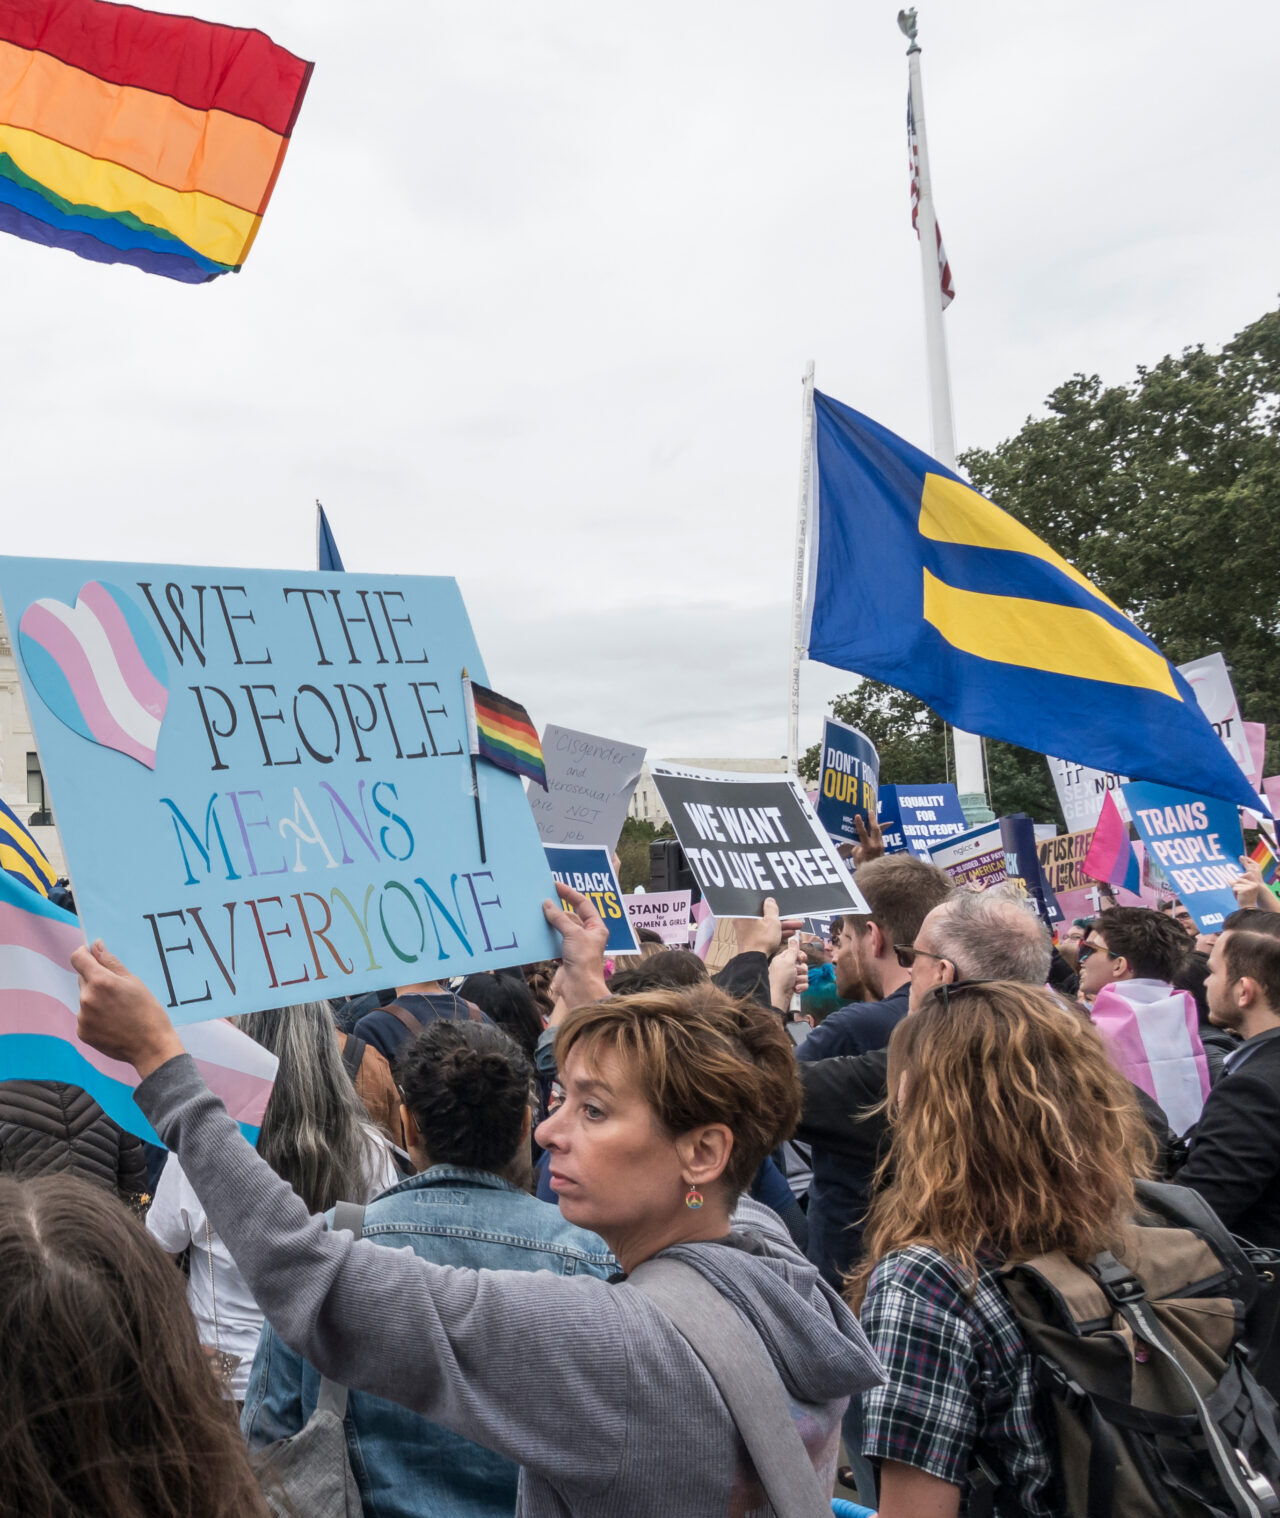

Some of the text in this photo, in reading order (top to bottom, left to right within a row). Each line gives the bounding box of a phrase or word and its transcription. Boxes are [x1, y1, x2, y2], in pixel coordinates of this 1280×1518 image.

[136, 582, 429, 667] WE THE
[188, 682, 464, 771] PEOPLE
[566, 766, 586, 777] and
[826, 747, 860, 777] DON'T
[824, 768, 858, 805] OUR
[898, 795, 945, 808] EQUALITY
[566, 804, 602, 820] NOT
[683, 802, 791, 844] WE WANT
[915, 810, 937, 822] FOR
[1136, 801, 1209, 837] TRANS
[159, 779, 415, 886] MEANS
[902, 823, 965, 836] GBTQ PEOPLE
[1151, 833, 1227, 867] PEOPLE
[685, 847, 842, 890] TO LIVE FREE
[1170, 863, 1244, 895] BELONG
[629, 903, 669, 915] STAND
[673, 901, 686, 912] UP
[669, 918, 687, 926] GIRLS
[143, 870, 518, 1008] EVERYONE
